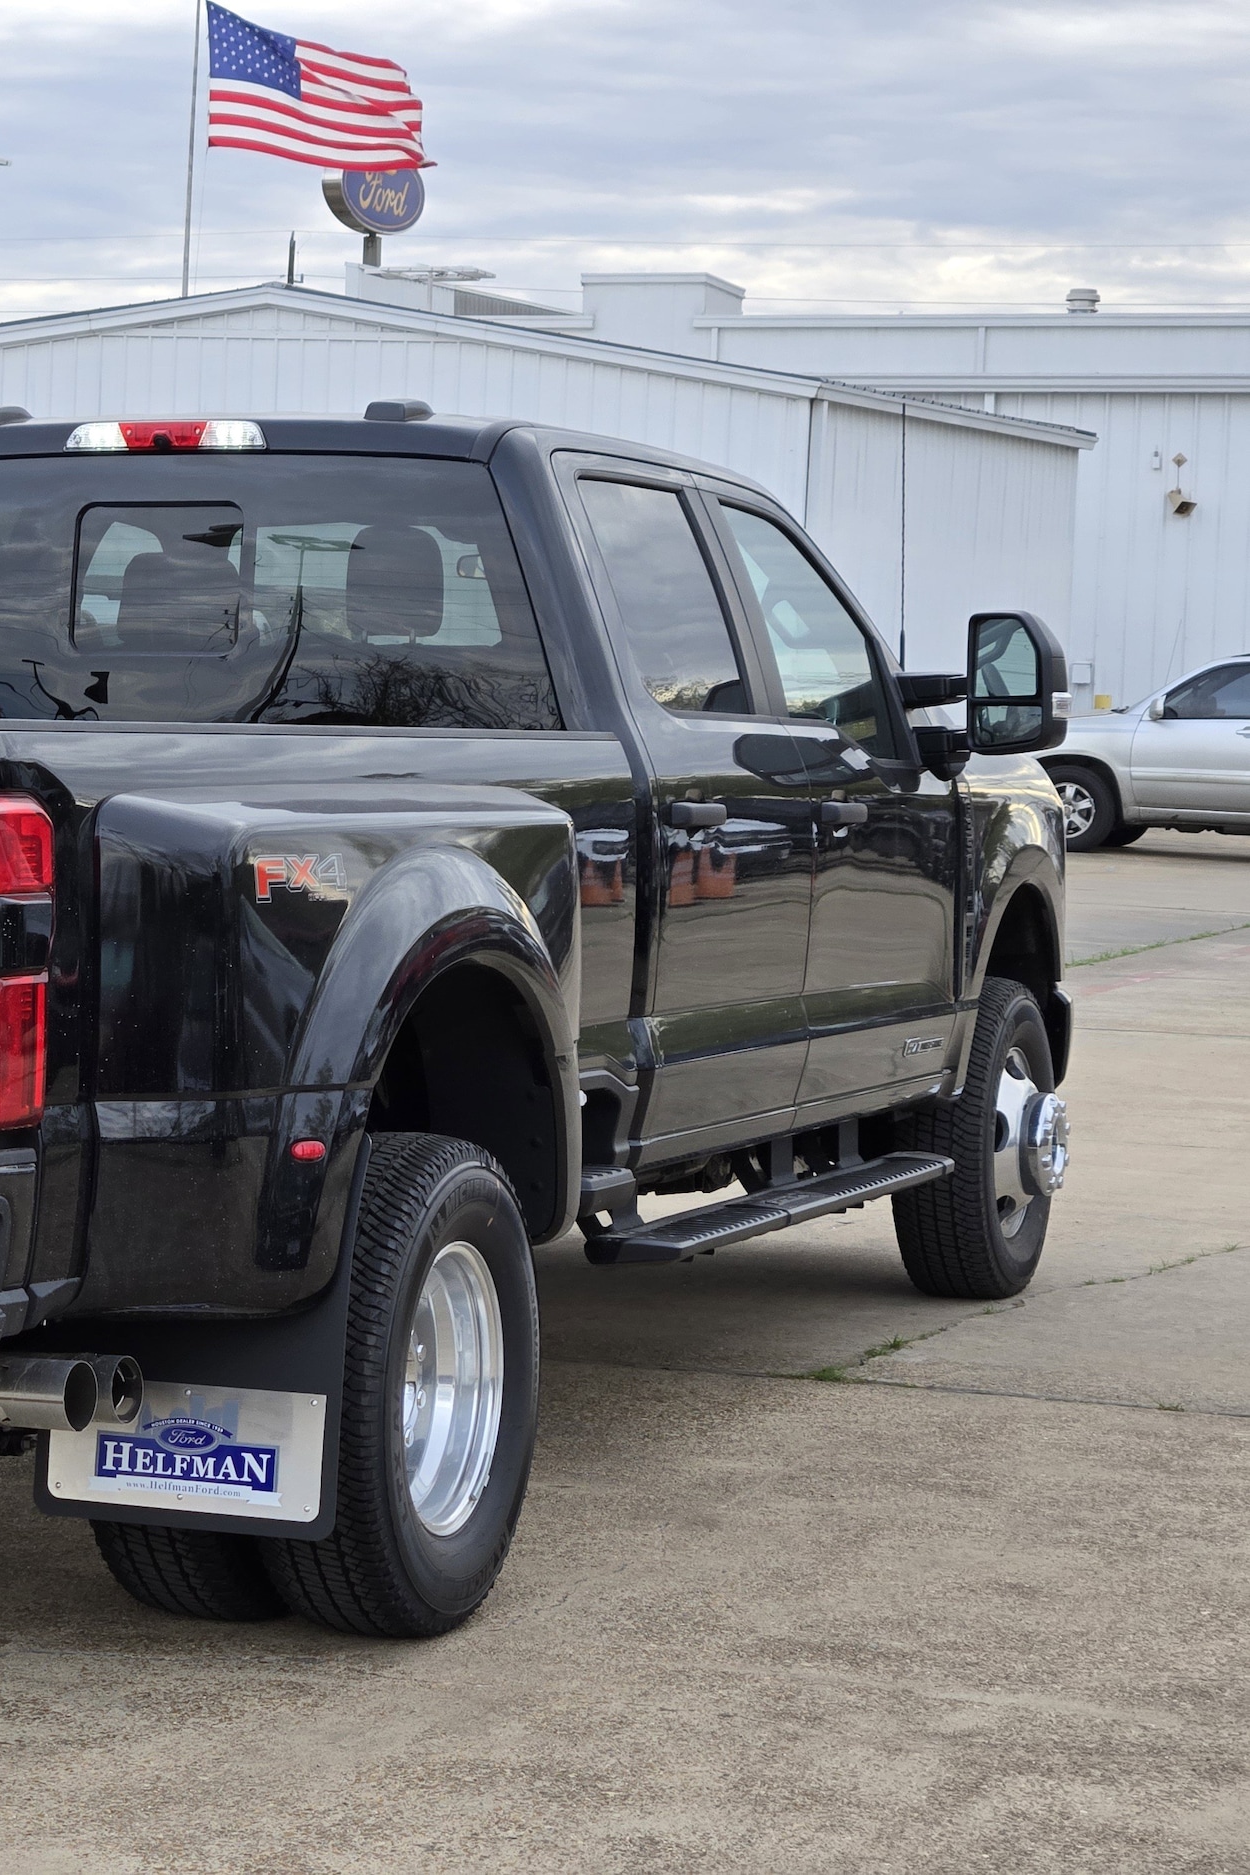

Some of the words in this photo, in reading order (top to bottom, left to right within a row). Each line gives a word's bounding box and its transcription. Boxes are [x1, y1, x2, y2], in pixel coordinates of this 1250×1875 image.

[359, 169, 410, 217] Ford
[253, 853, 348, 904] FX4
[151, 1419, 175, 1428] HOUSTON
[196, 1419, 211, 1428] SINCE
[168, 1429, 207, 1446] Ford
[102, 1440, 271, 1484] HELFMAN
[126, 1480, 241, 1498] www.HelfmanFord.com
